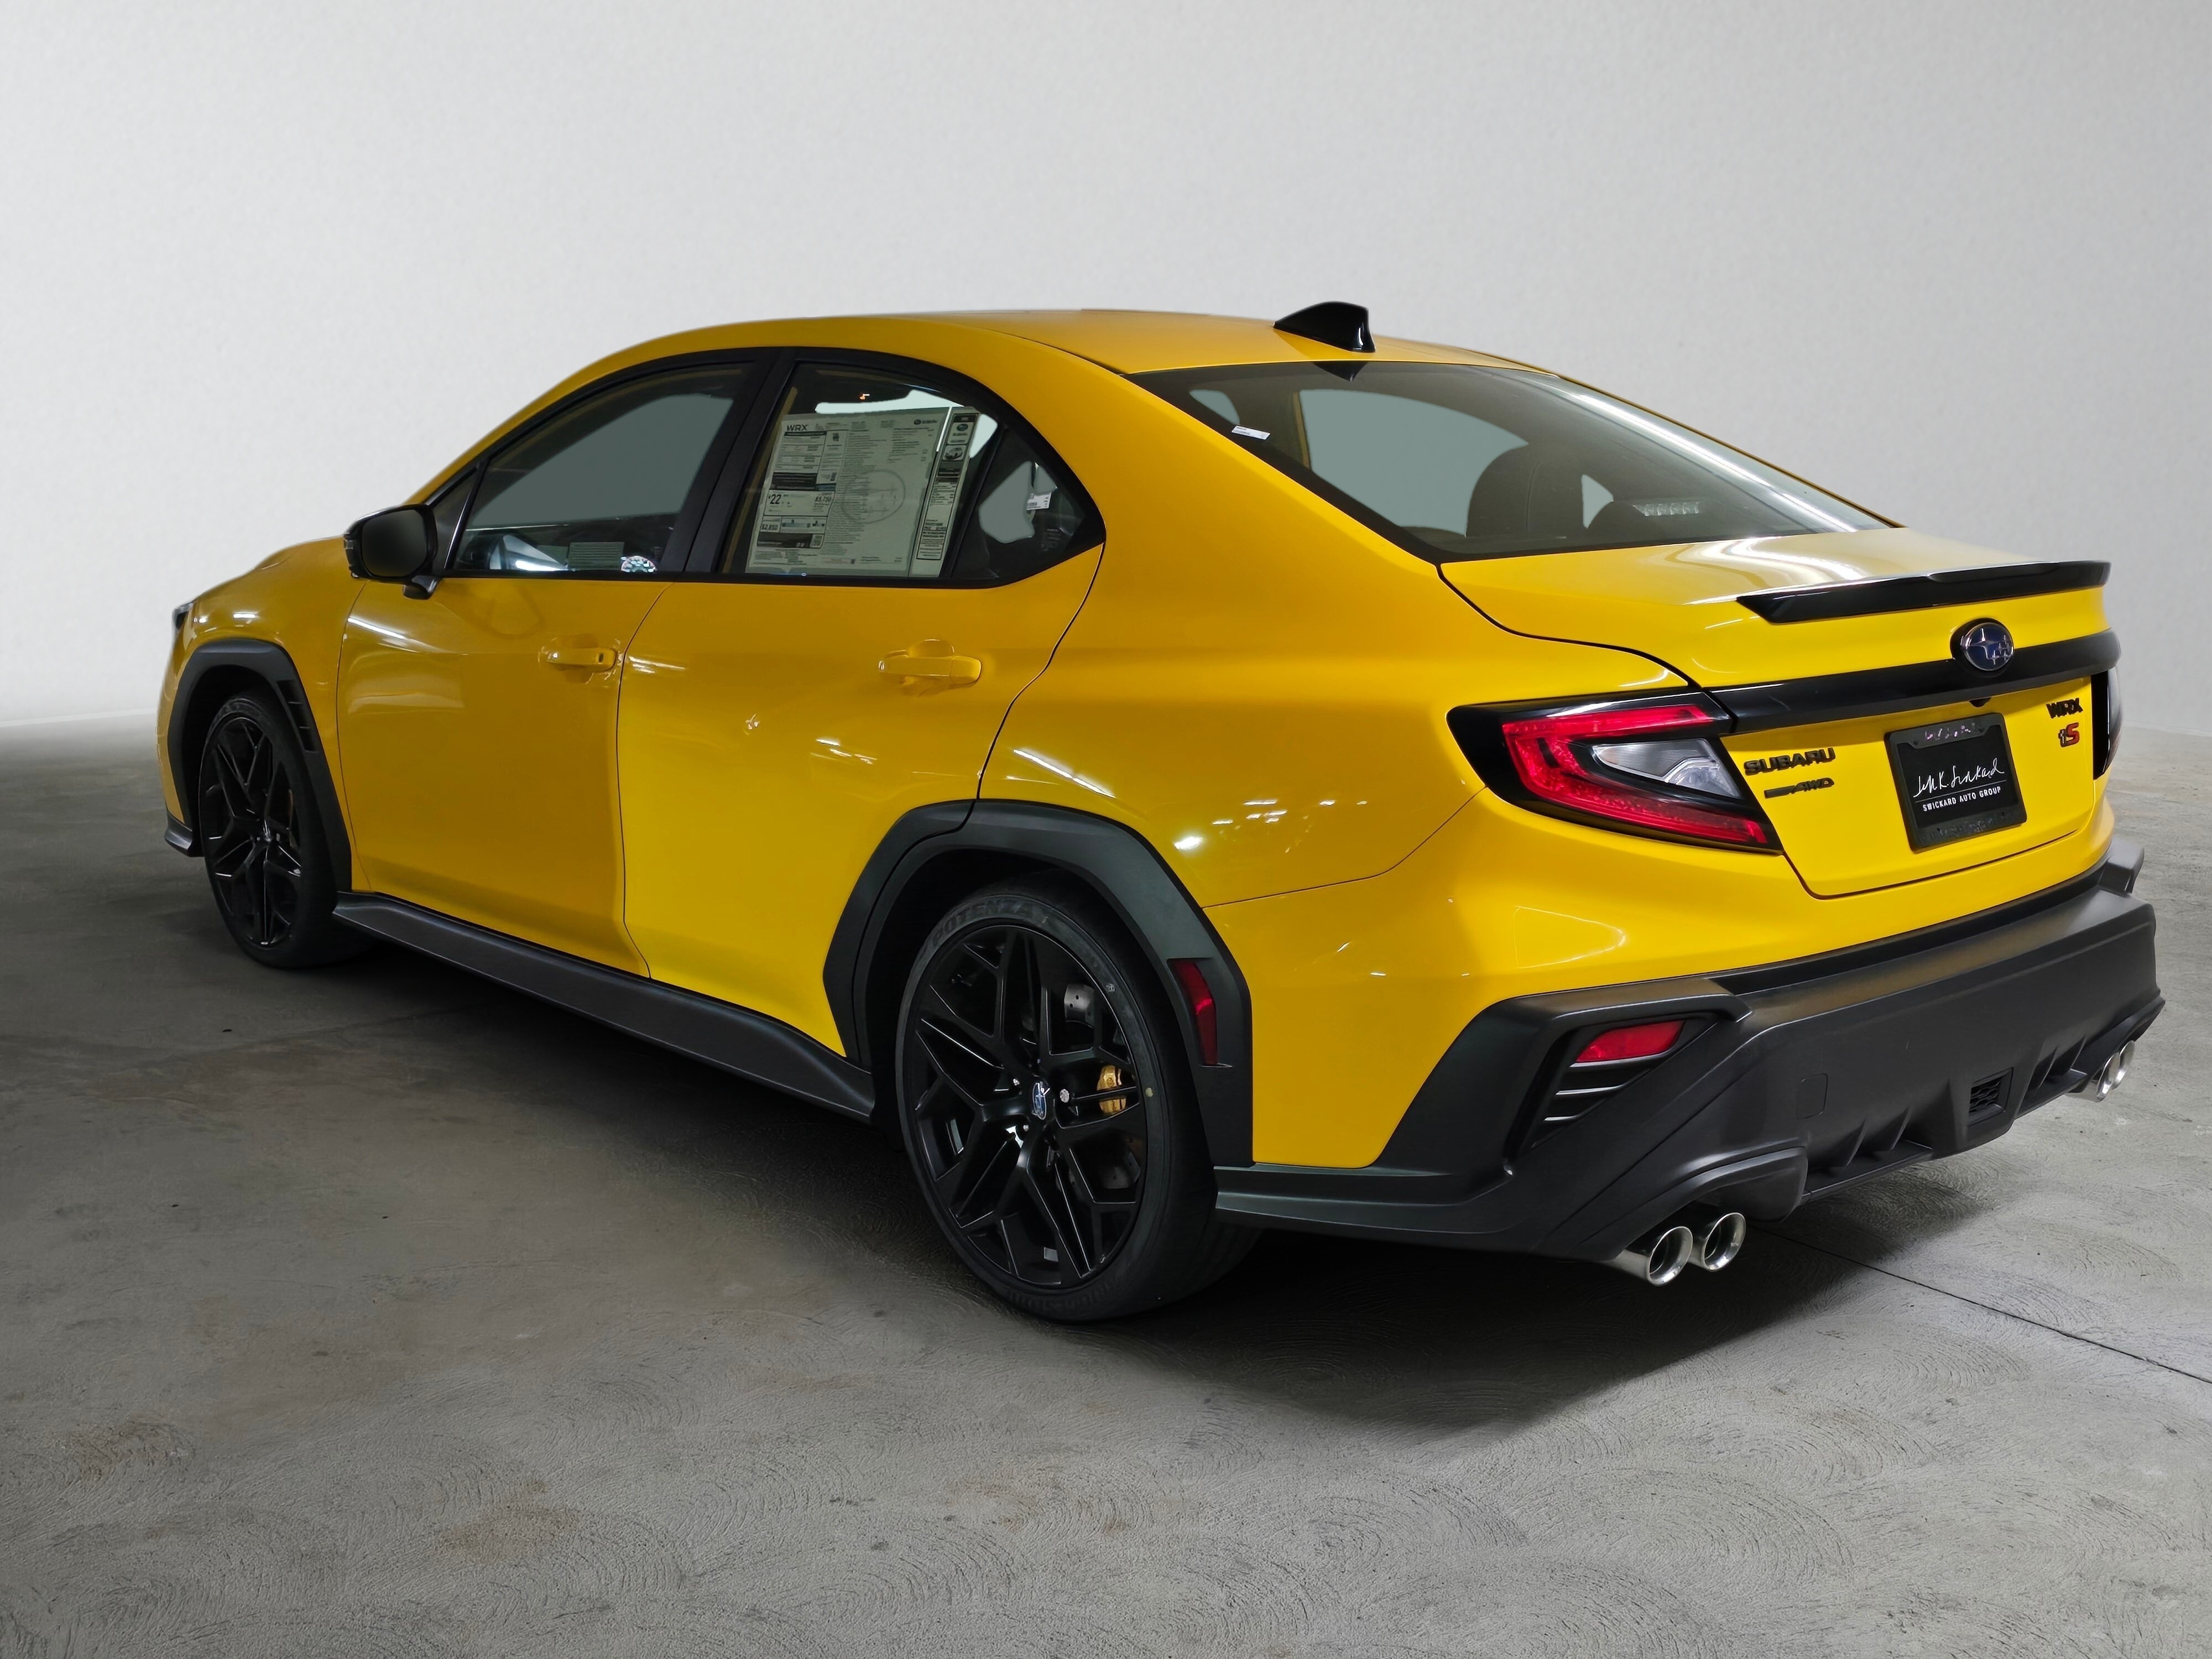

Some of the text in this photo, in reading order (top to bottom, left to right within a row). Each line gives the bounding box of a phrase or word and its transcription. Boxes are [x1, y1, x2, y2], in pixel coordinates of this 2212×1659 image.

[770, 494, 782, 504] 22
[2046, 697, 2083, 718] WRX
[1744, 747, 1836, 776] SUBARU
[1923, 786, 2001, 812] SWICKARD AUTO GROUP
